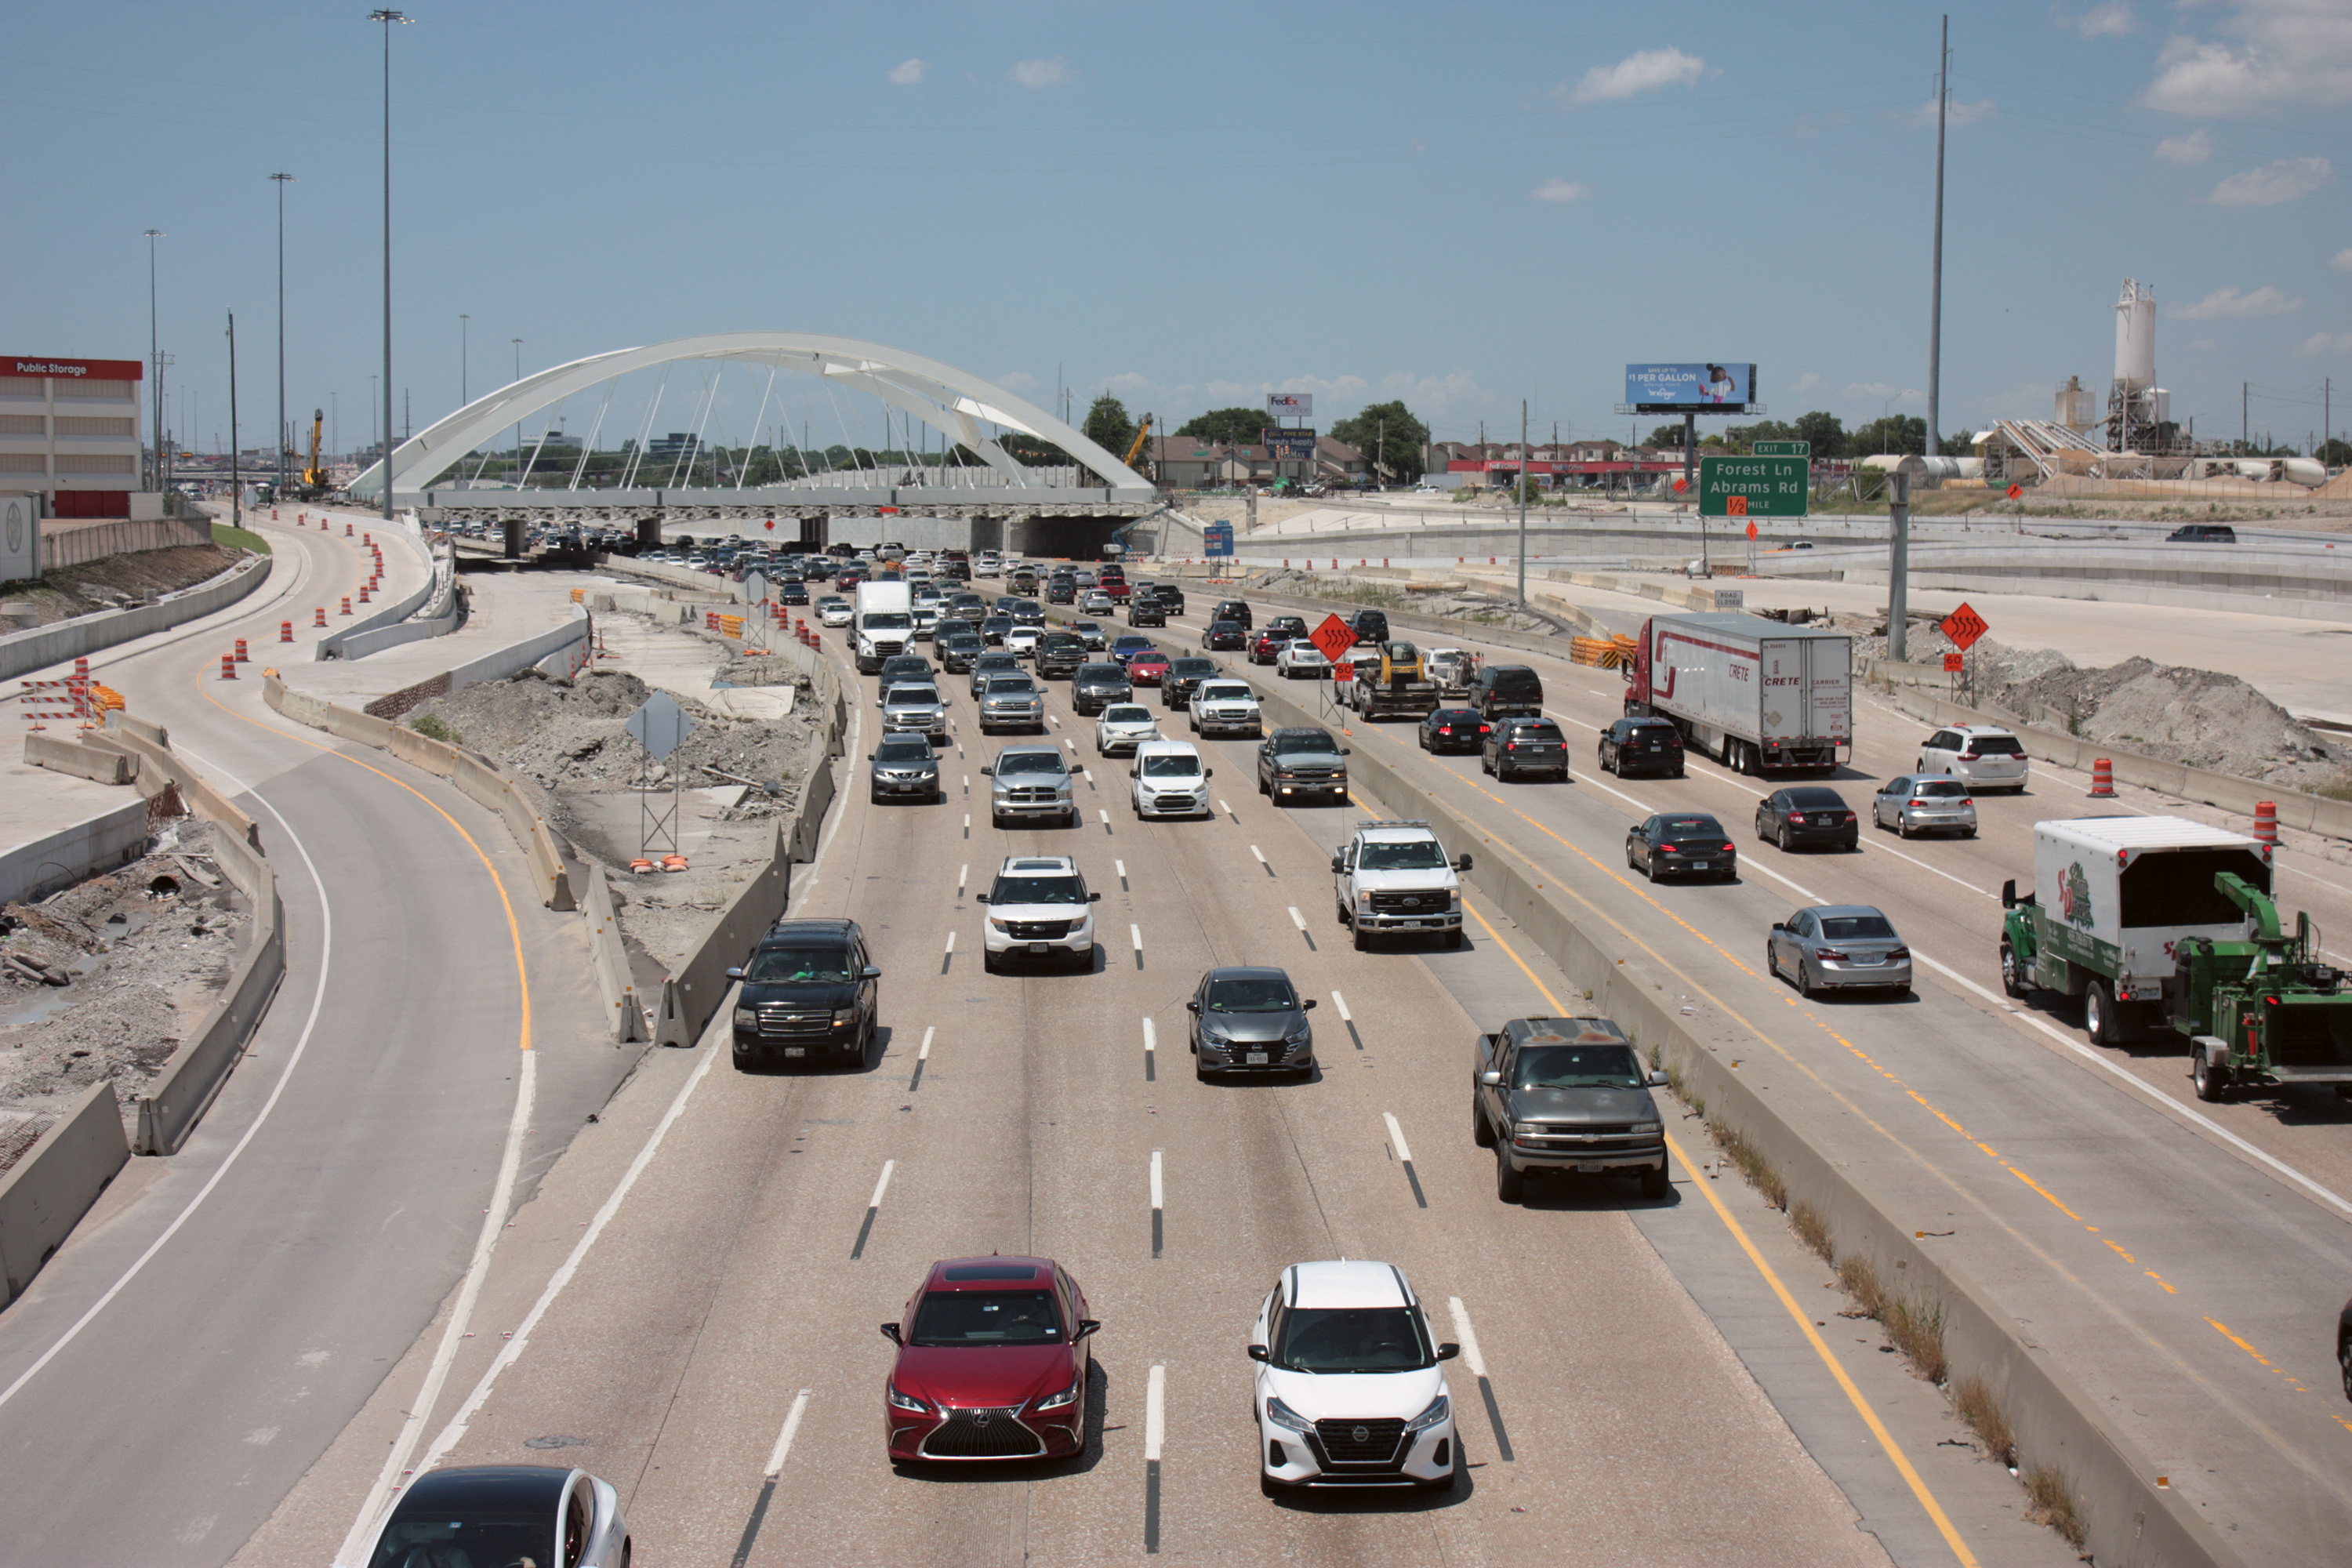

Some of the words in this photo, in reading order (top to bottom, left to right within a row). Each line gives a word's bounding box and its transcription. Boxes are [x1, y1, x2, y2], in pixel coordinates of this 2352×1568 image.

[16, 362, 47, 372] Public
[49, 364, 87, 376] Storage
[1658, 373, 1697, 382] GALLON
[1656, 388, 1676, 401] Kroger
[1271, 397, 1298, 405] FedEx
[1758, 445, 1778, 453] EXIT
[1791, 444, 1805, 454] 17
[1716, 463, 1766, 475] Forest
[1775, 464, 1792, 475] Ln
[1710, 481, 1770, 493] Abrams
[1779, 481, 1798, 493] Rd
[1729, 499, 1744, 514] 1/2
[1946, 655, 1962, 664] 60
[1337, 665, 1352, 674] 60
[1729, 663, 1749, 682] CRETE
[1765, 677, 1800, 687] CRETE
